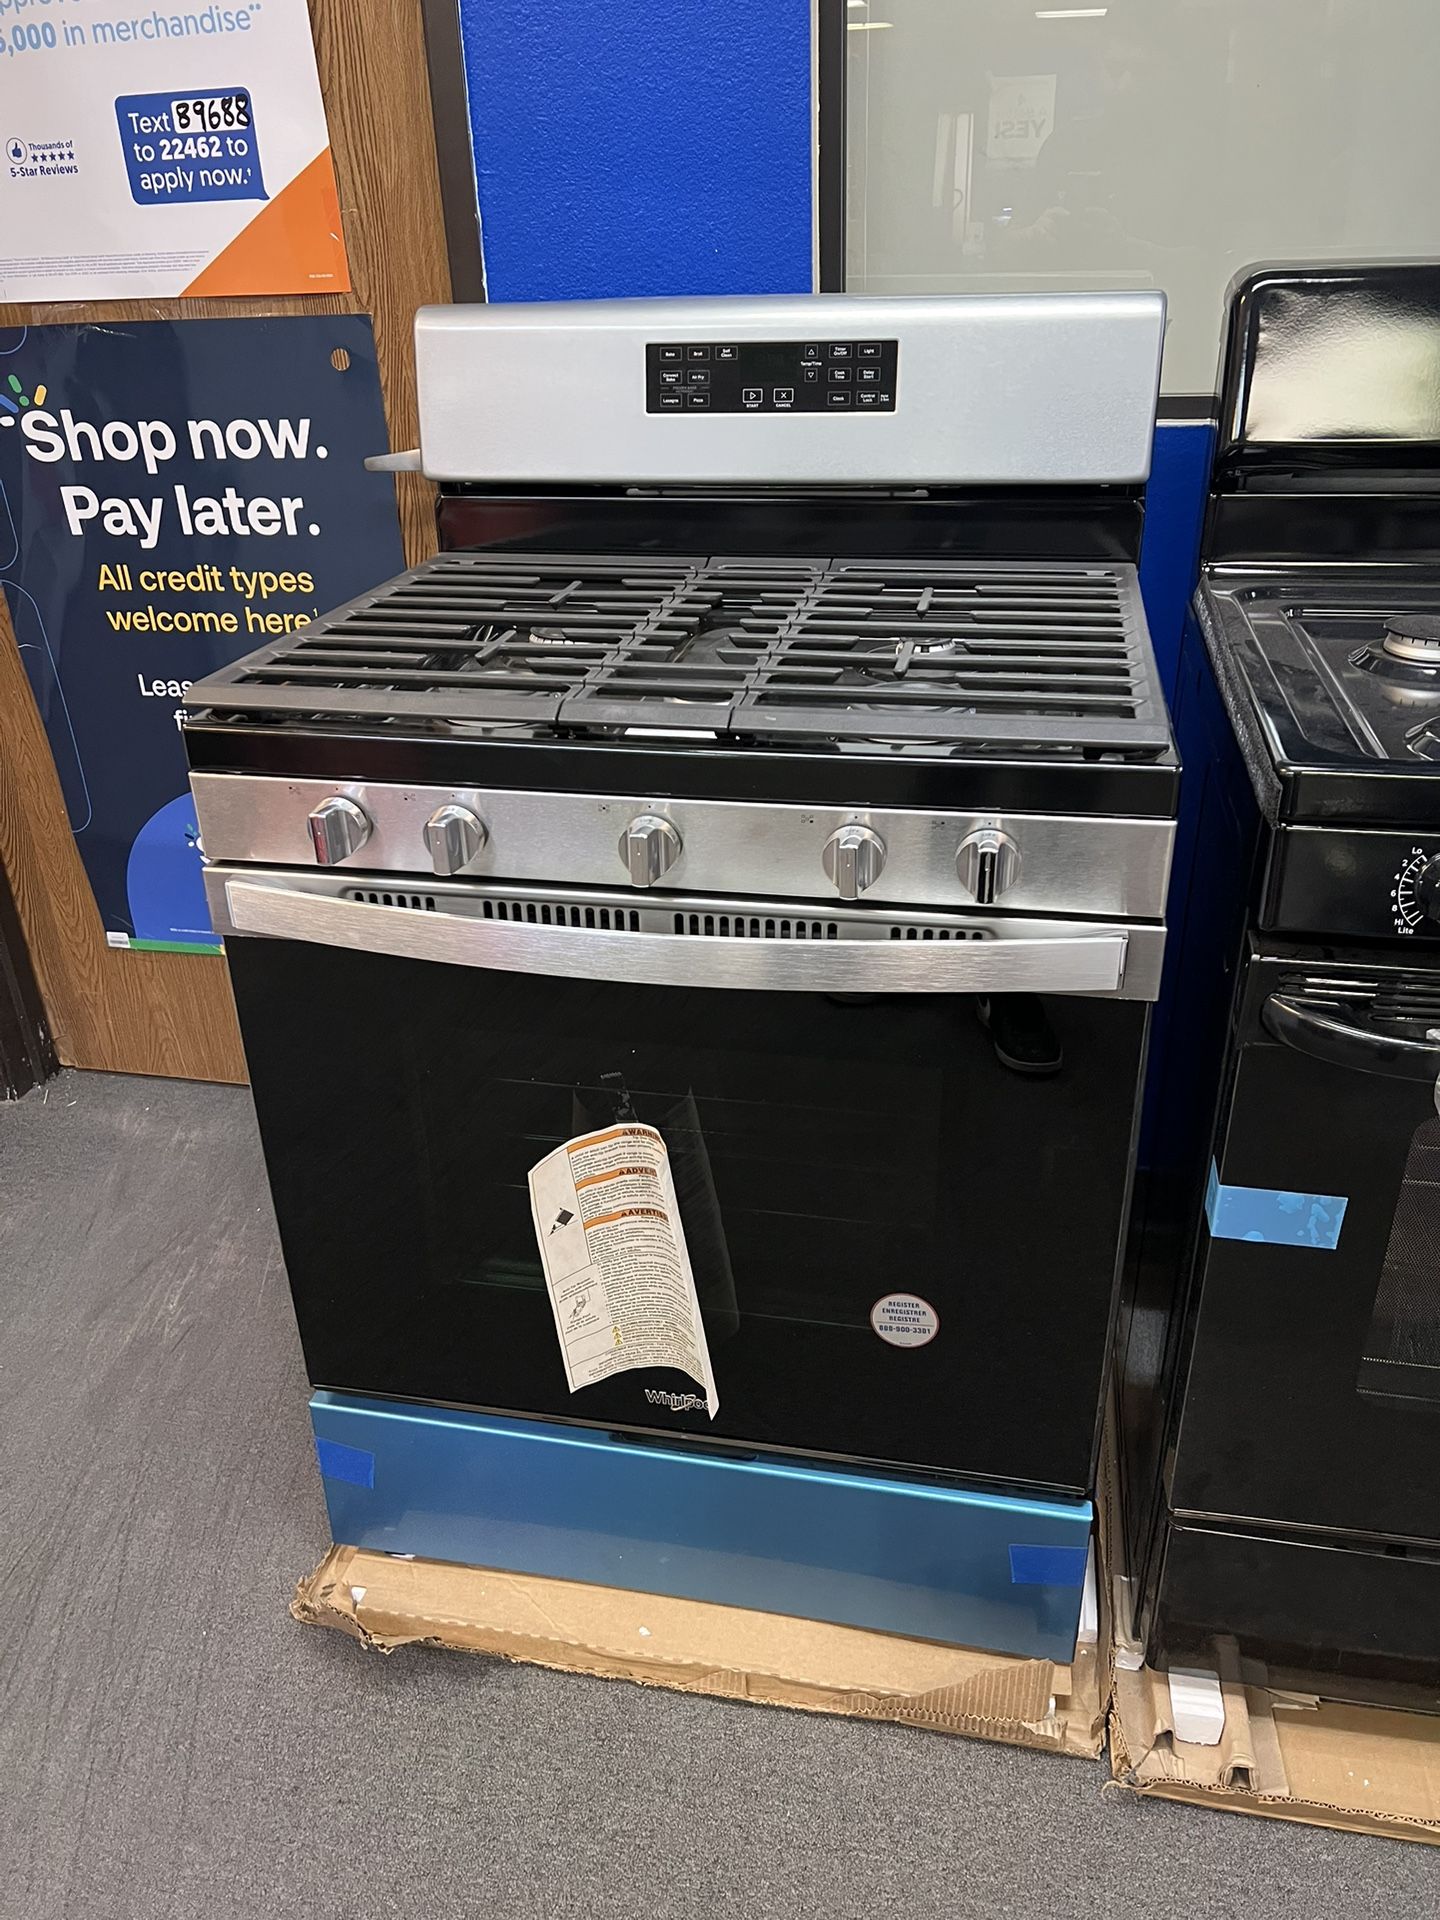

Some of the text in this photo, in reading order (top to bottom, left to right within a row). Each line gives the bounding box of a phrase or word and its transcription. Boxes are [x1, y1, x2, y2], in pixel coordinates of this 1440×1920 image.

[62, 19, 86, 46] in
[128, 112, 171, 134] Text
[175, 93, 251, 132] 89688
[28, 139, 73, 151] Thousands of
[134, 136, 248, 162] to 22462 to
[10, 163, 79, 178] 5-Star Reviews
[140, 166, 194, 195] apply
[20, 409, 328, 474] Shop now.
[59, 484, 320, 549] Pay later.
[98, 564, 315, 600] All credit types
[106, 605, 239, 634] welcome
[1411, 847, 1423, 855] Lo
[1402, 859, 1408, 867] 2
[1394, 918, 1404, 926] Hi
[1397, 927, 1414, 935] Lite
[882, 1308, 927, 1317] ENREGISTRER
[888, 1301, 920, 1309] REGISTER
